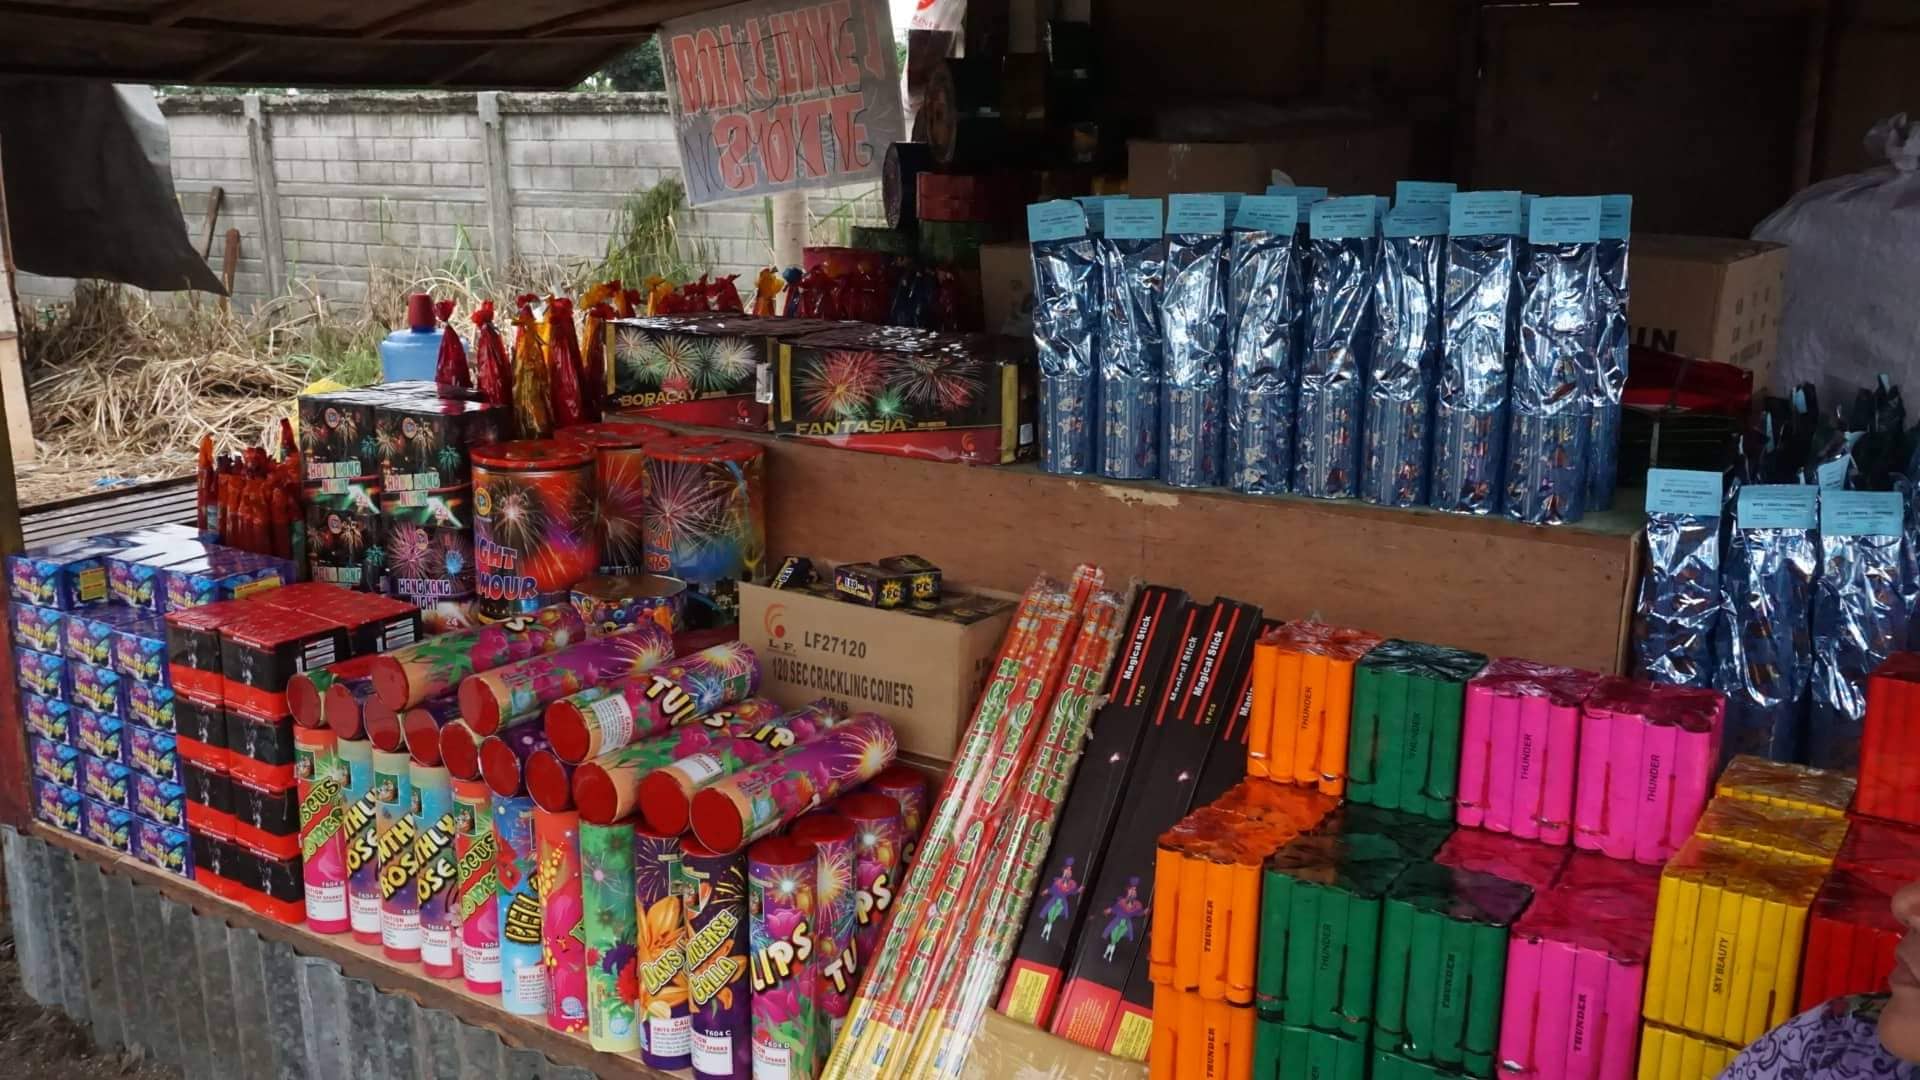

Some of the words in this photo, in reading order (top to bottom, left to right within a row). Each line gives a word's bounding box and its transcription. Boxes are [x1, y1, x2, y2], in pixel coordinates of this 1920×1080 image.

[621, 390, 698, 407] BORACAY
[795, 419, 907, 435] FANTASIA
[400, 578, 424, 595] HONG
[424, 579, 450, 596] KONG
[804, 631, 868, 659] LF27120
[1123, 641, 1143, 680] Magical
[1137, 615, 1152, 641] Stick
[1193, 656, 1212, 697] Magical
[1207, 630, 1225, 657] Stick
[773, 656, 789, 683] 120
[790, 661, 809, 687] SEC
[810, 665, 868, 700] CRACKLING
[870, 676, 915, 710] COMETS
[1301, 686, 1313, 730] THUNDER
[983, 679, 1043, 804] ROMAN
[1520, 733, 1532, 781] THUNDER
[1647, 754, 1660, 802] THUNDER
[1204, 900, 1214, 953] THUNDER
[1320, 923, 1332, 971] THUNDER
[1574, 994, 1587, 1052] THUNDER
[1207, 1028, 1216, 1080] THUNDER
